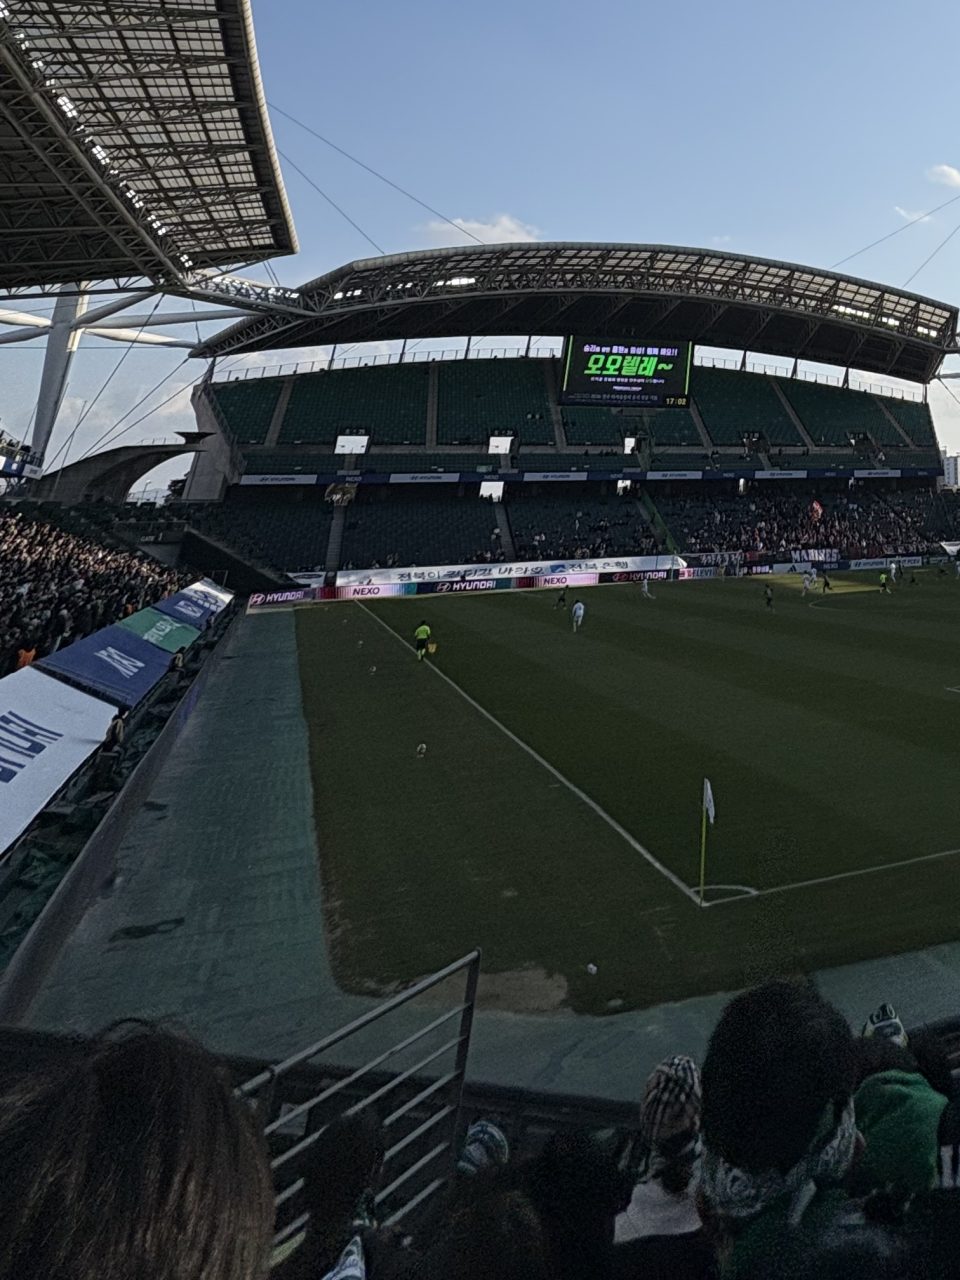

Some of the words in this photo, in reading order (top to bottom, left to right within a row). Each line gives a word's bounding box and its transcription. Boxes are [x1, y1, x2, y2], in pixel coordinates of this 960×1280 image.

[665, 397, 687, 406] 17:02
[543, 576, 568, 585] NEXO
[629, 571, 667, 581] HYUNDAI
[452, 581, 497, 590] HYUNDAI
[352, 587, 380, 596] NEXO
[266, 591, 304, 604] HYUNDAI
